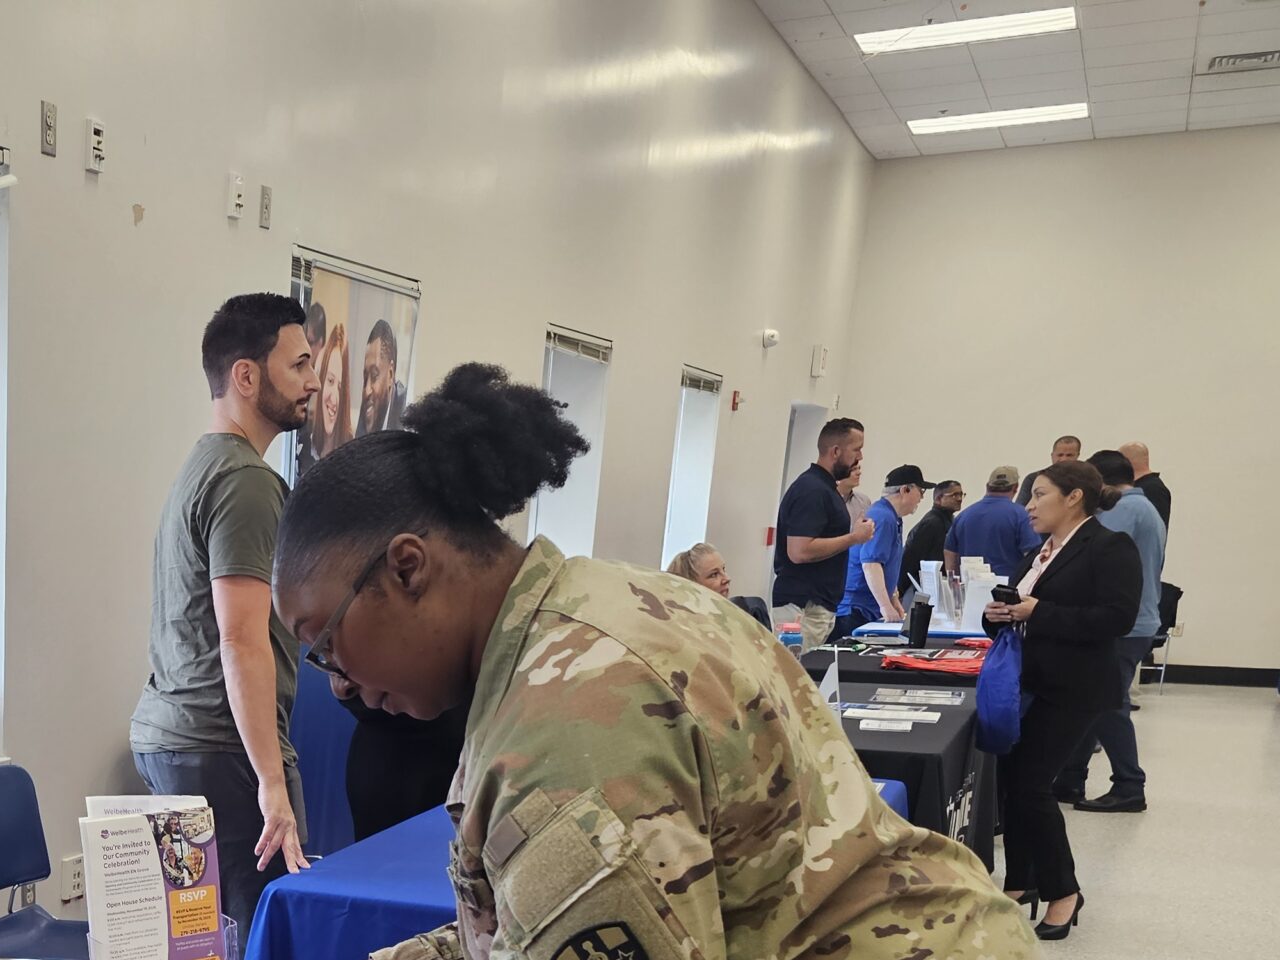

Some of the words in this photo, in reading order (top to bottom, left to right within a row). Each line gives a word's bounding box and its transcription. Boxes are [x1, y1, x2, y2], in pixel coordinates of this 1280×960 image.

[102, 844, 121, 852] You're
[122, 841, 143, 849] Invited
[115, 849, 150, 859] Community
[104, 859, 141, 869] Celebration!
[139, 895, 163, 904] Schedule
[180, 889, 207, 903] RSVP
